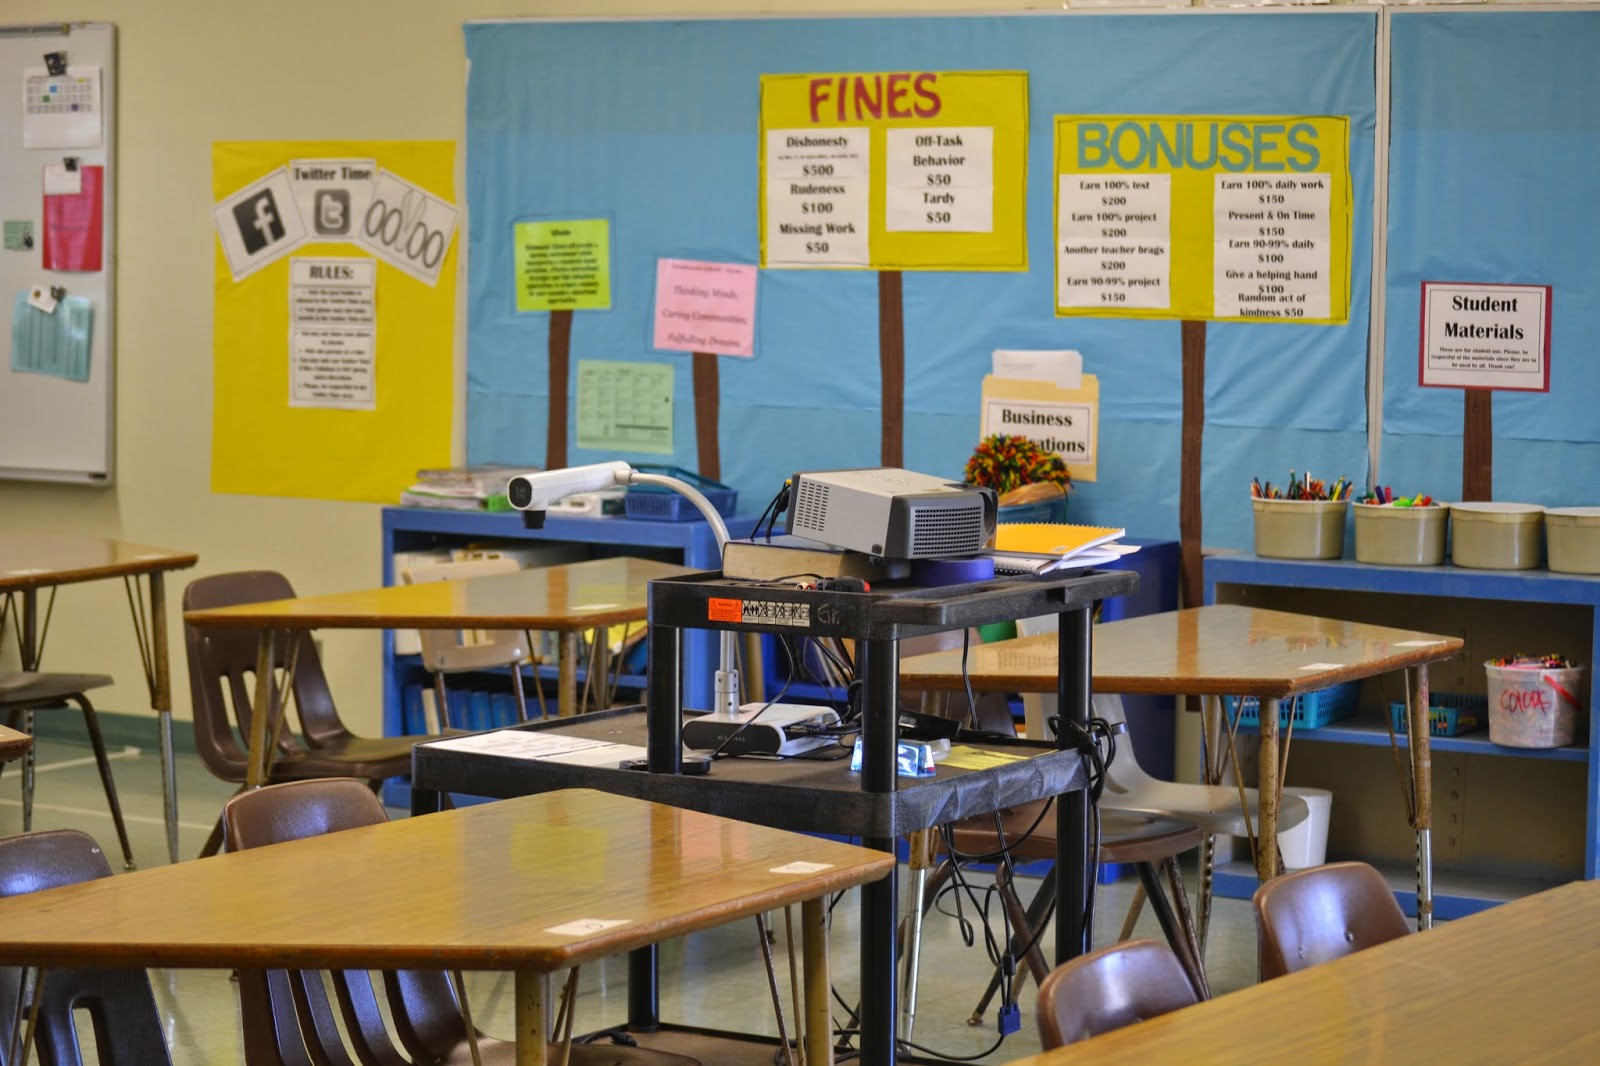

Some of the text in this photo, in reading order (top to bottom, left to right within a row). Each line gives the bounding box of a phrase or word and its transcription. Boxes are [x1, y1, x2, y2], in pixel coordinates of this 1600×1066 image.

[808, 72, 943, 123] FINES
[786, 136, 849, 149] Dishonesty
[915, 135, 964, 148] Off-Task
[1076, 121, 1321, 173] BONUSES
[912, 155, 966, 167] Behavior
[294, 166, 372, 182] Twitter Time
[802, 164, 835, 177] $500
[926, 174, 952, 187] $50
[1080, 181, 1150, 190] Earn 100% test
[1221, 179, 1325, 191] Earn 100% daily work
[790, 184, 846, 196] Rudeness
[922, 192, 957, 207] Tardy
[1101, 196, 1127, 206] $200
[1258, 195, 1285, 205] $150
[802, 202, 834, 214] $100
[926, 212, 952, 224] $50
[1071, 212, 1157, 224] Earn 100% project
[1228, 211, 1316, 221] Present & On Time
[780, 223, 856, 236] Missing Work
[1101, 228, 1127, 238] $200
[1258, 227, 1285, 236] $150
[806, 241, 830, 254] $50
[1229, 238, 1315, 250] Earn 90-99% daily
[1064, 245, 1165, 257] Another teacher brags
[1258, 254, 1284, 264] $100
[1101, 261, 1126, 271] $200
[309, 265, 354, 280] RULES:
[1225, 270, 1318, 281] Give a helping hand
[1067, 277, 1161, 288] Earn 90-99% project
[1258, 284, 1284, 294] $100
[1101, 292, 1126, 302] $150
[1238, 293, 1306, 303] Random act of
[1452, 295, 1518, 313] Student
[1239, 307, 1304, 318] kindness $50
[1444, 322, 1524, 341] Materials
[1001, 408, 1073, 427] Business
